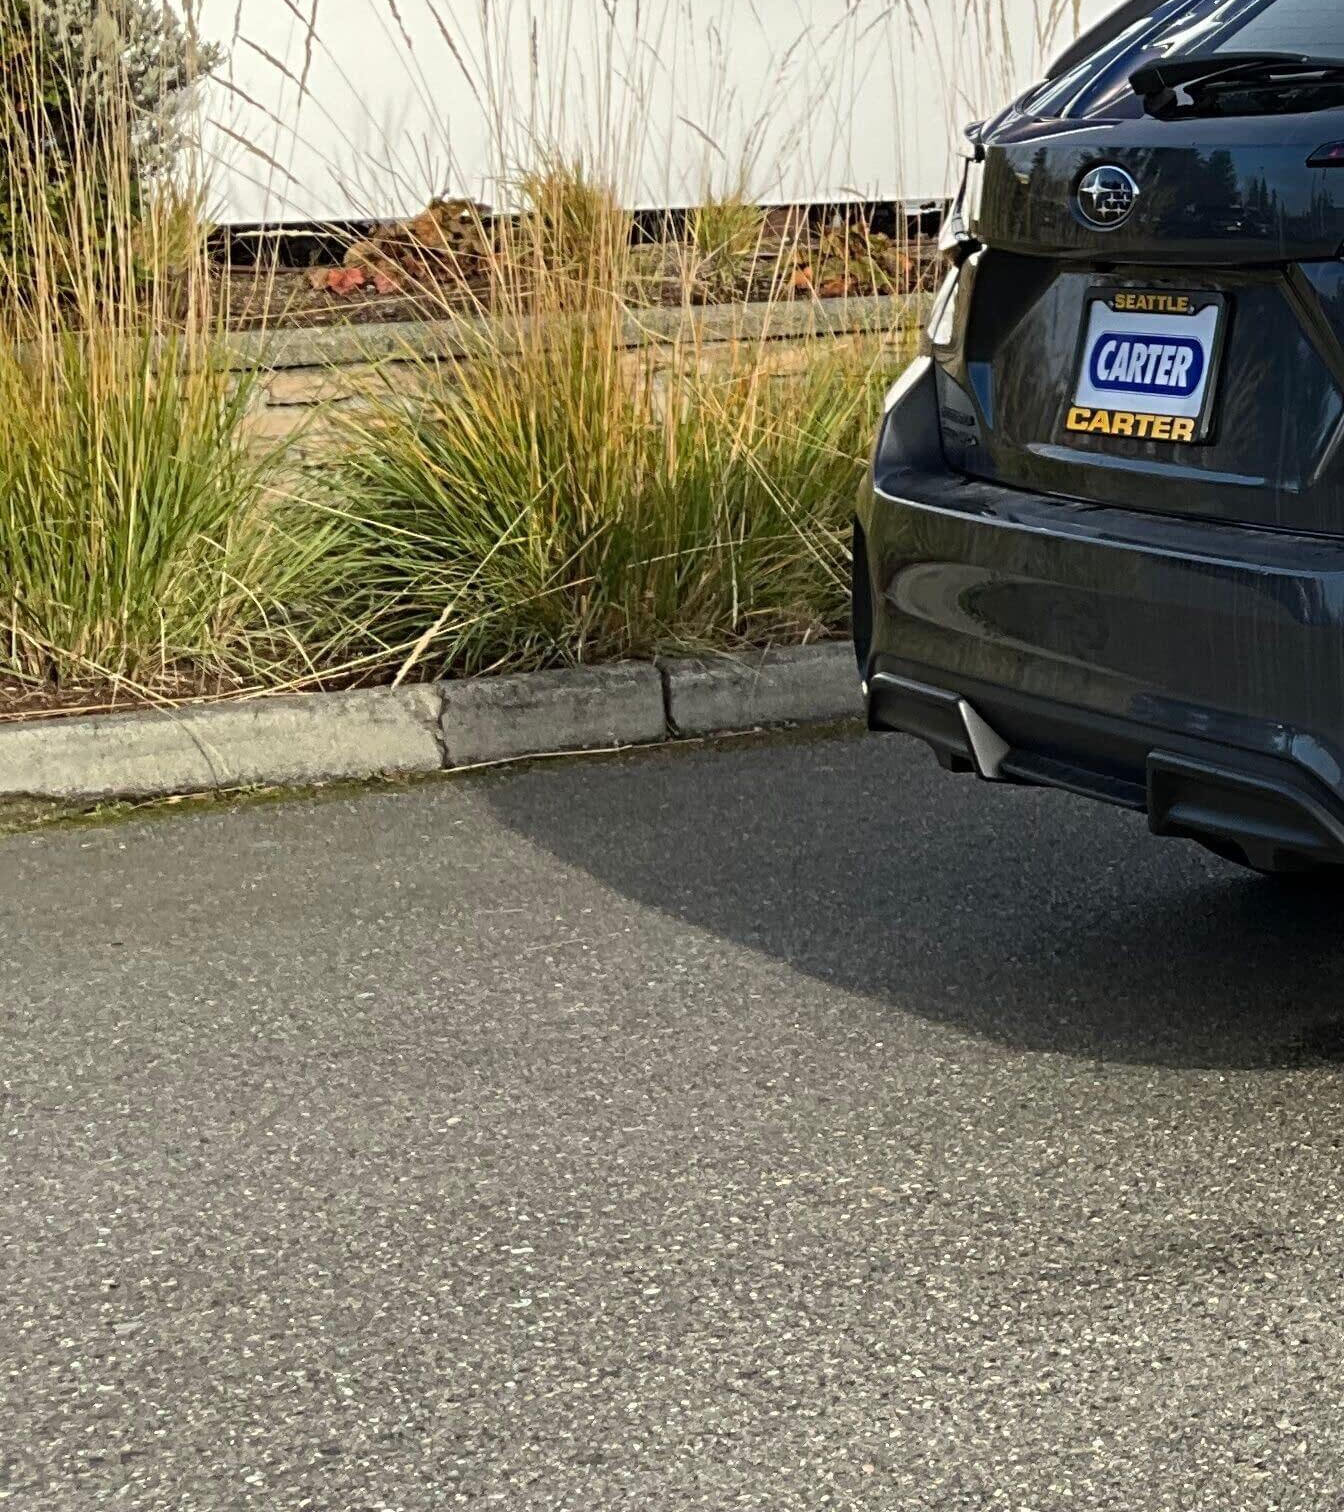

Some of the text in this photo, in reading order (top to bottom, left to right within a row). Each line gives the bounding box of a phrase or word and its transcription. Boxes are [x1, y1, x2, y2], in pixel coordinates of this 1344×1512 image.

[1114, 293, 1190, 313] SEATTLE
[1096, 339, 1194, 388] CARTER
[1066, 407, 1196, 442] CARTER
